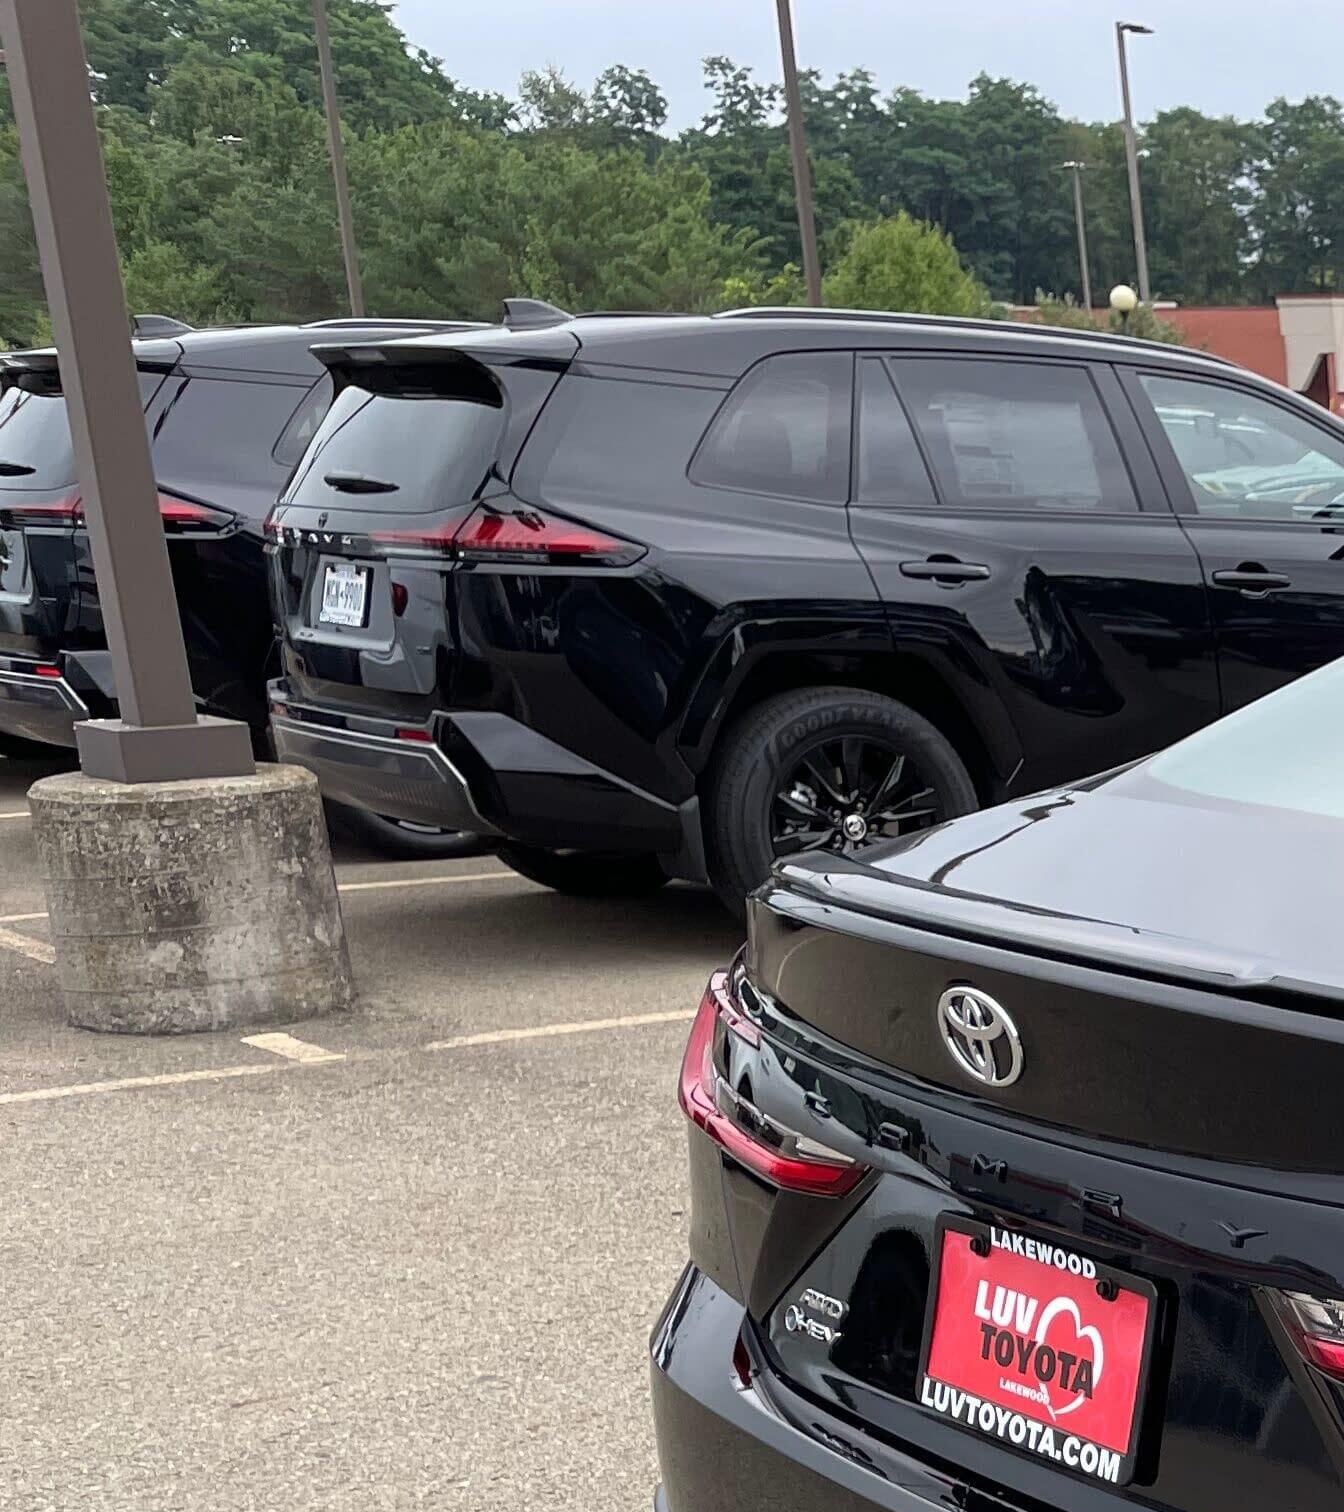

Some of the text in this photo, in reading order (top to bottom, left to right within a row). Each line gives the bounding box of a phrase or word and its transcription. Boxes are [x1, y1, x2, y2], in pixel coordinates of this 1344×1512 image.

[990, 1226, 1096, 1279] LAKEWOOD
[974, 1280, 1038, 1335] LUV
[980, 1323, 1093, 1399] TOYOTA
[999, 1376, 1050, 1404] LAKEWOOD
[921, 1377, 1121, 1483] LUVTOYOTA.COM
